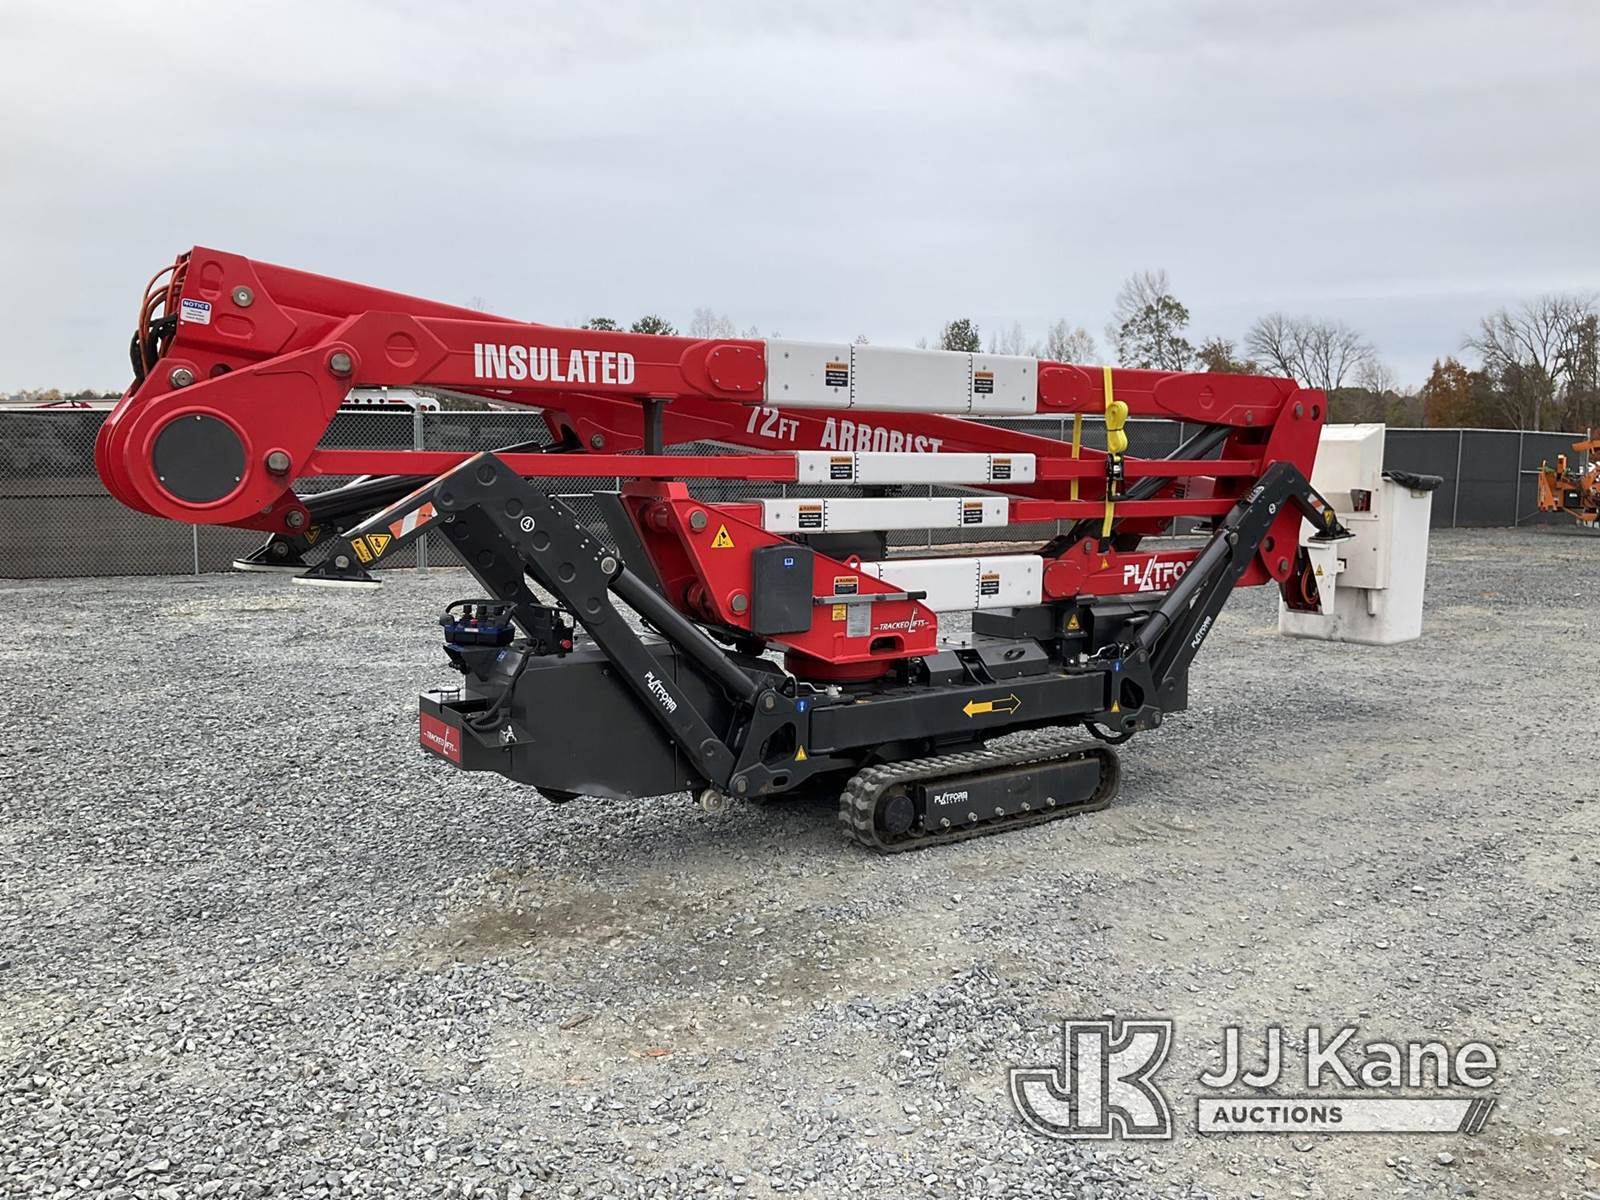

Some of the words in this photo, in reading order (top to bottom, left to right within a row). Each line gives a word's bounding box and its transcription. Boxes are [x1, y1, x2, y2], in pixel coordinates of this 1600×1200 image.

[183, 300, 210, 310] NOTICE
[473, 342, 635, 385] INSULATED
[820, 416, 944, 453] ARBORIST
[1123, 554, 1194, 592] PLATFO
[880, 620, 910, 631] TRACKED
[644, 671, 677, 713] PLATFORM
[934, 791, 968, 805] PLATFORM
